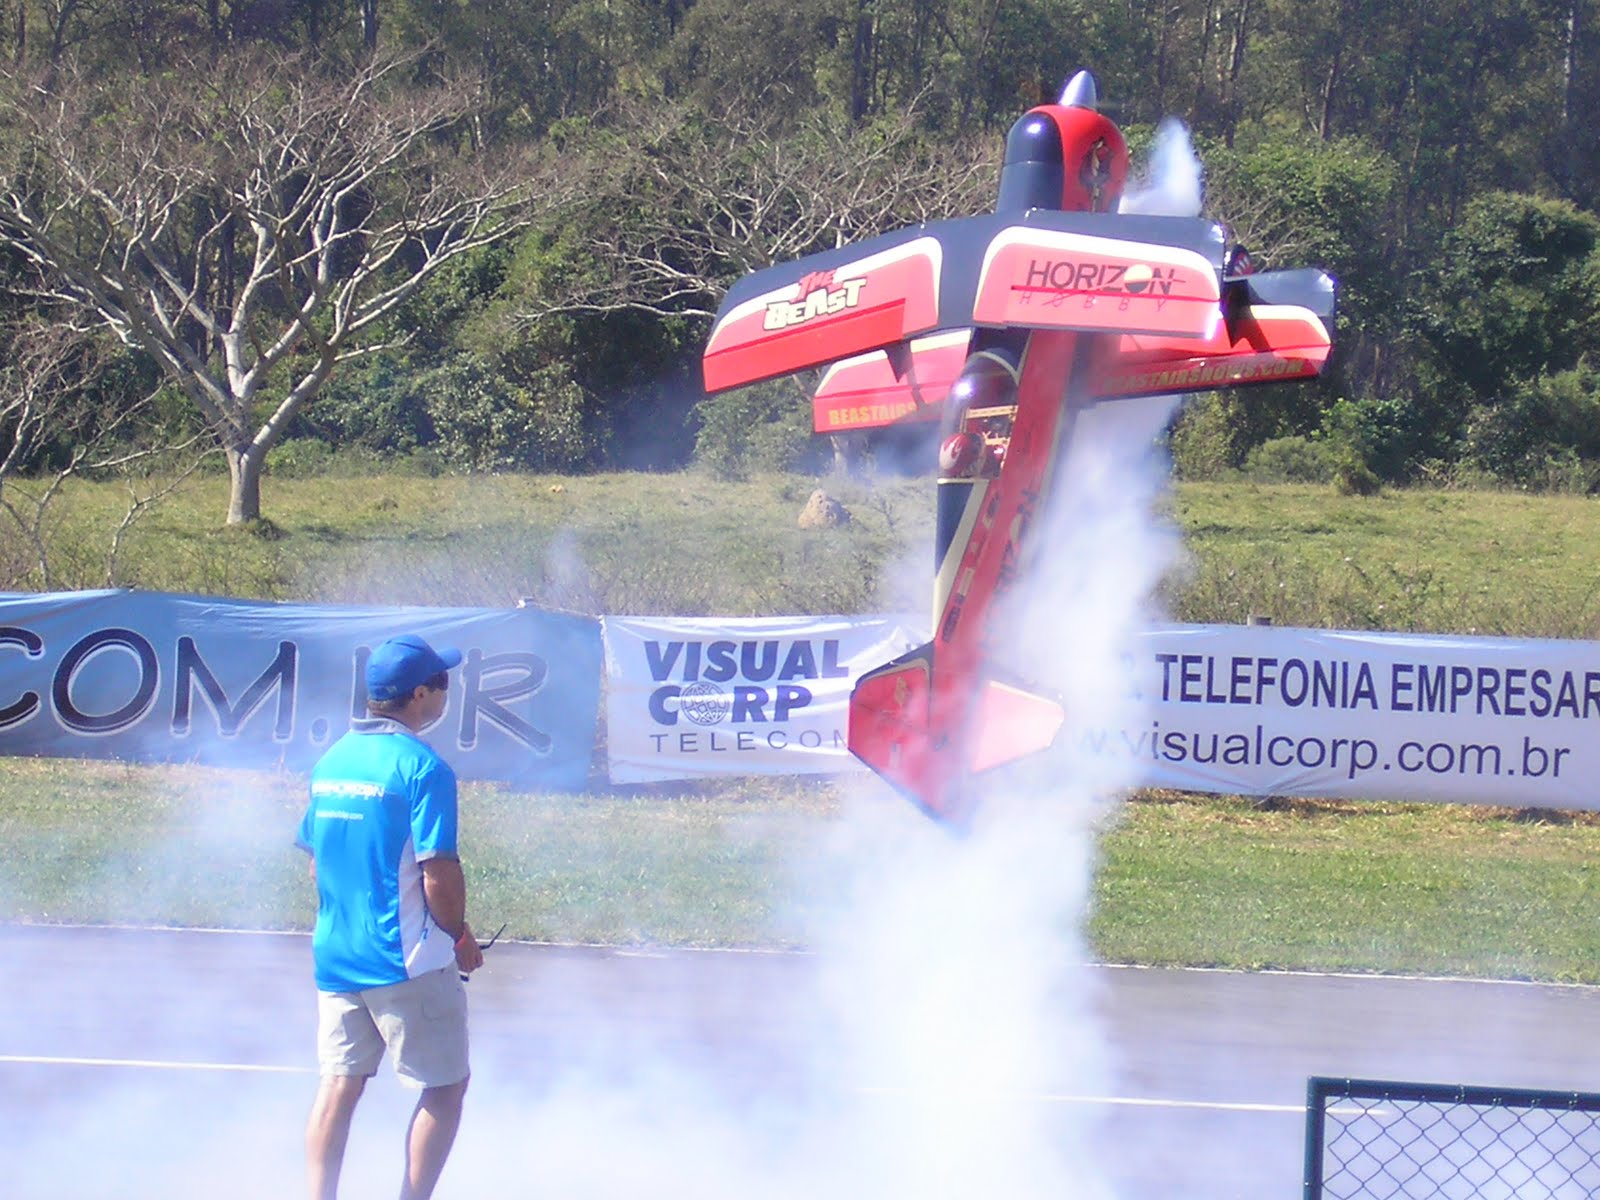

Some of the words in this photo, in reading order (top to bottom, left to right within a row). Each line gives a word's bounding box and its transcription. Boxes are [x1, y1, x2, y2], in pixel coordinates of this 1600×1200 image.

[791, 270, 837, 302] THE
[1026, 260, 1174, 294] HORIZON
[763, 277, 867, 331] BEAST
[1019, 292, 1168, 312] HOBBY
[643, 639, 849, 682] VISUAL
[648, 681, 813, 727] CORP
[1155, 653, 1379, 711] TELEFONIA
[1391, 663, 1600, 719] EMPRESAR
